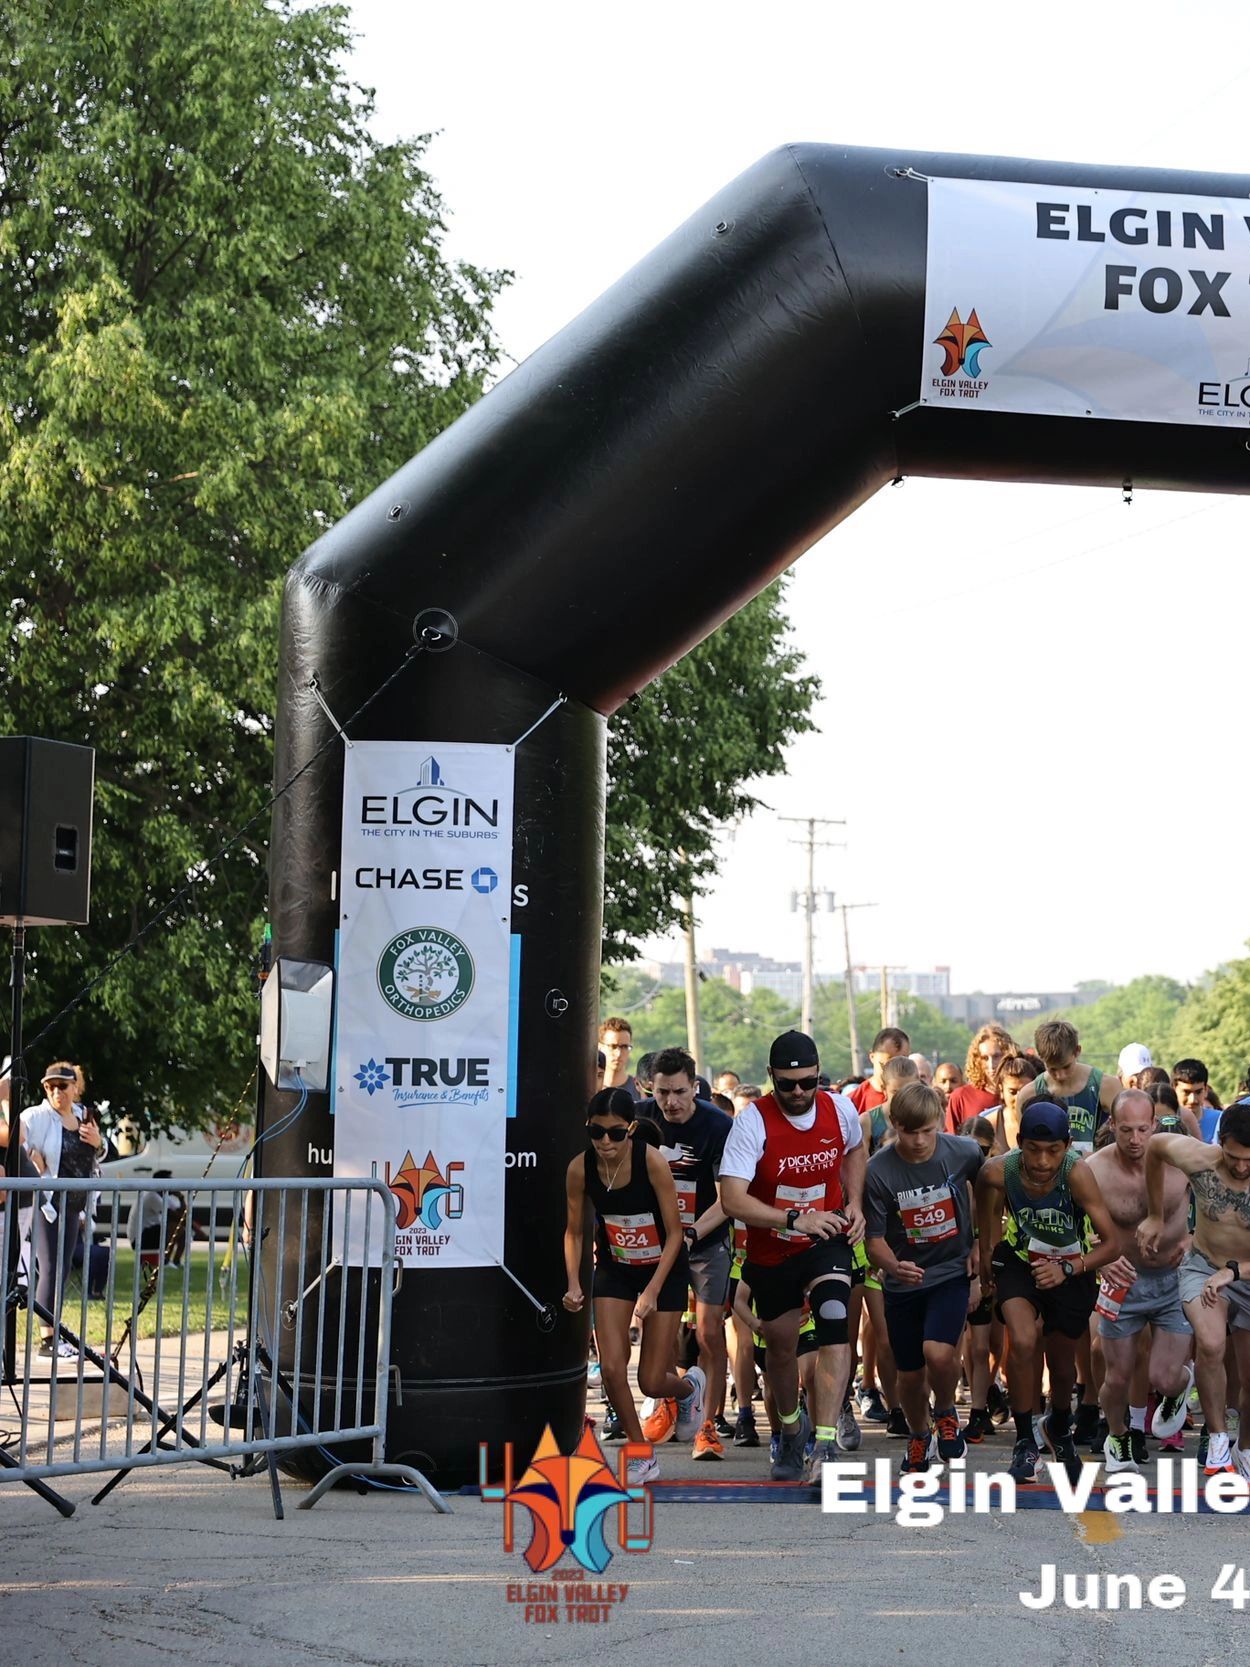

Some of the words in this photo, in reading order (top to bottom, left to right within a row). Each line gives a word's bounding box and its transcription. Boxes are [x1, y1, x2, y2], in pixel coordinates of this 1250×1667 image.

[1036, 202, 1225, 251] ELGIN
[1104, 264, 1231, 317] FOX
[932, 379, 956, 388] ELGIN
[958, 380, 988, 390] VALLEY
[940, 388, 955, 397] FOX
[958, 389, 979, 398] TROT
[361, 795, 498, 826] ELGIN
[361, 828, 381, 836] THE
[384, 829, 406, 837] CITY
[409, 829, 420, 837] IN
[423, 830, 444, 838] THE
[447, 830, 498, 839] SUBURBS
[355, 867, 464, 890] CHASE
[390, 933, 414, 956] FOX
[419, 931, 465, 957] VALLEY
[384, 984, 466, 1018] ORTHOPEDICS
[385, 1057, 490, 1087] TRUE
[392, 1088, 438, 1102] Insurance
[440, 1091, 448, 1100] &
[449, 1088, 489, 1105] Benefits
[787, 1154, 811, 1167] DICK
[812, 1147, 839, 1163] POND
[795, 1160, 834, 1174] RACING
[913, 1208, 946, 1227] 549
[395, 1235, 412, 1245] GIN
[415, 1235, 450, 1245] VALLEY
[615, 1232, 649, 1247] 924
[394, 1246, 413, 1256] FOX
[416, 1246, 441, 1256] TROT
